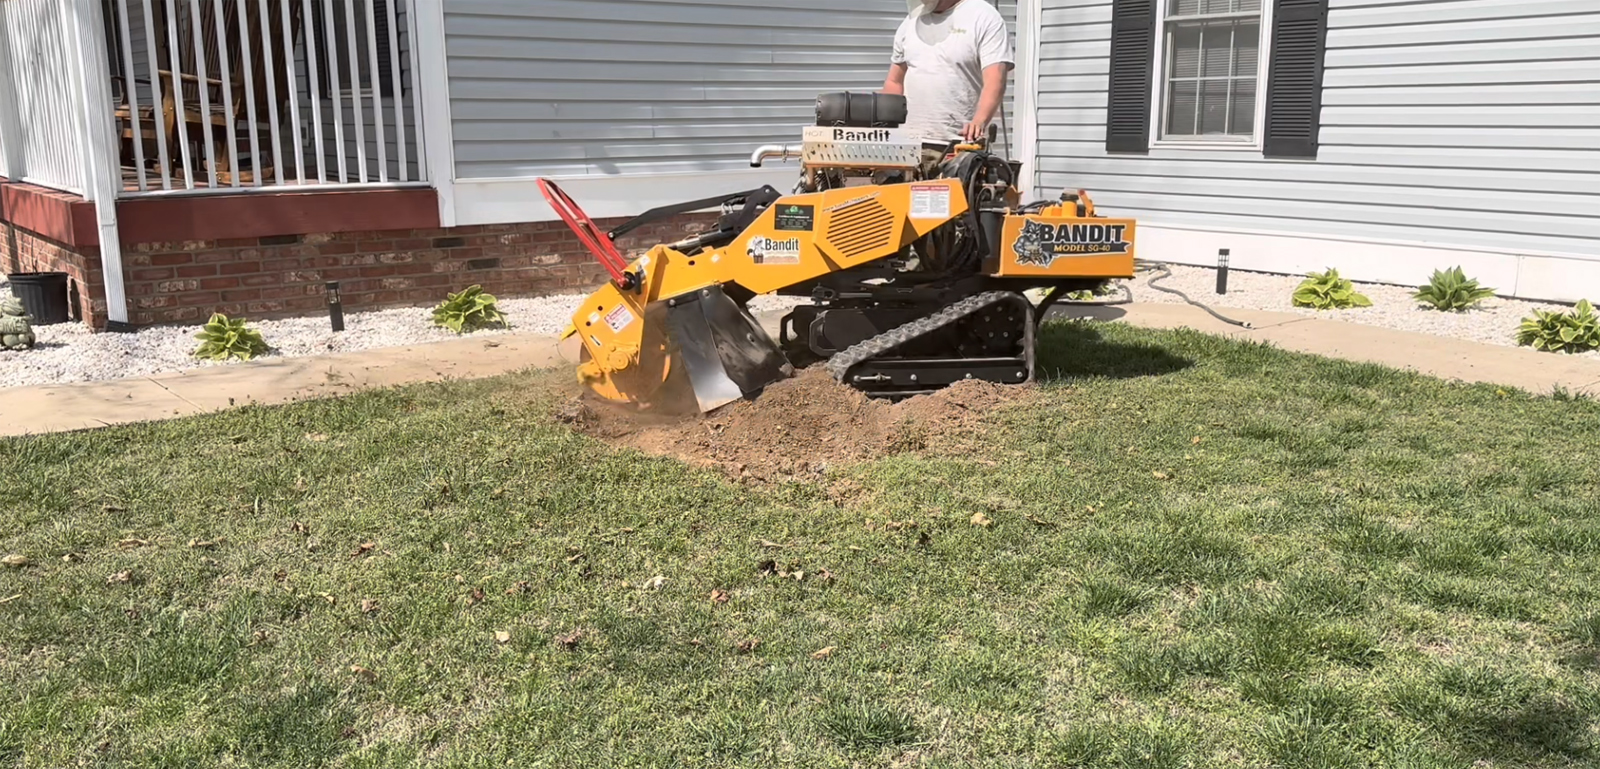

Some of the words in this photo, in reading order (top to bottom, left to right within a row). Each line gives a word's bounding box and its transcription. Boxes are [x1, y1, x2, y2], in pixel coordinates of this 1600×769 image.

[833, 128, 890, 142] Bandit
[1040, 224, 1125, 242] BANDIT
[765, 238, 799, 251] Bandit
[1053, 244, 1085, 252] MODEL
[1088, 244, 1111, 252] SG-40
